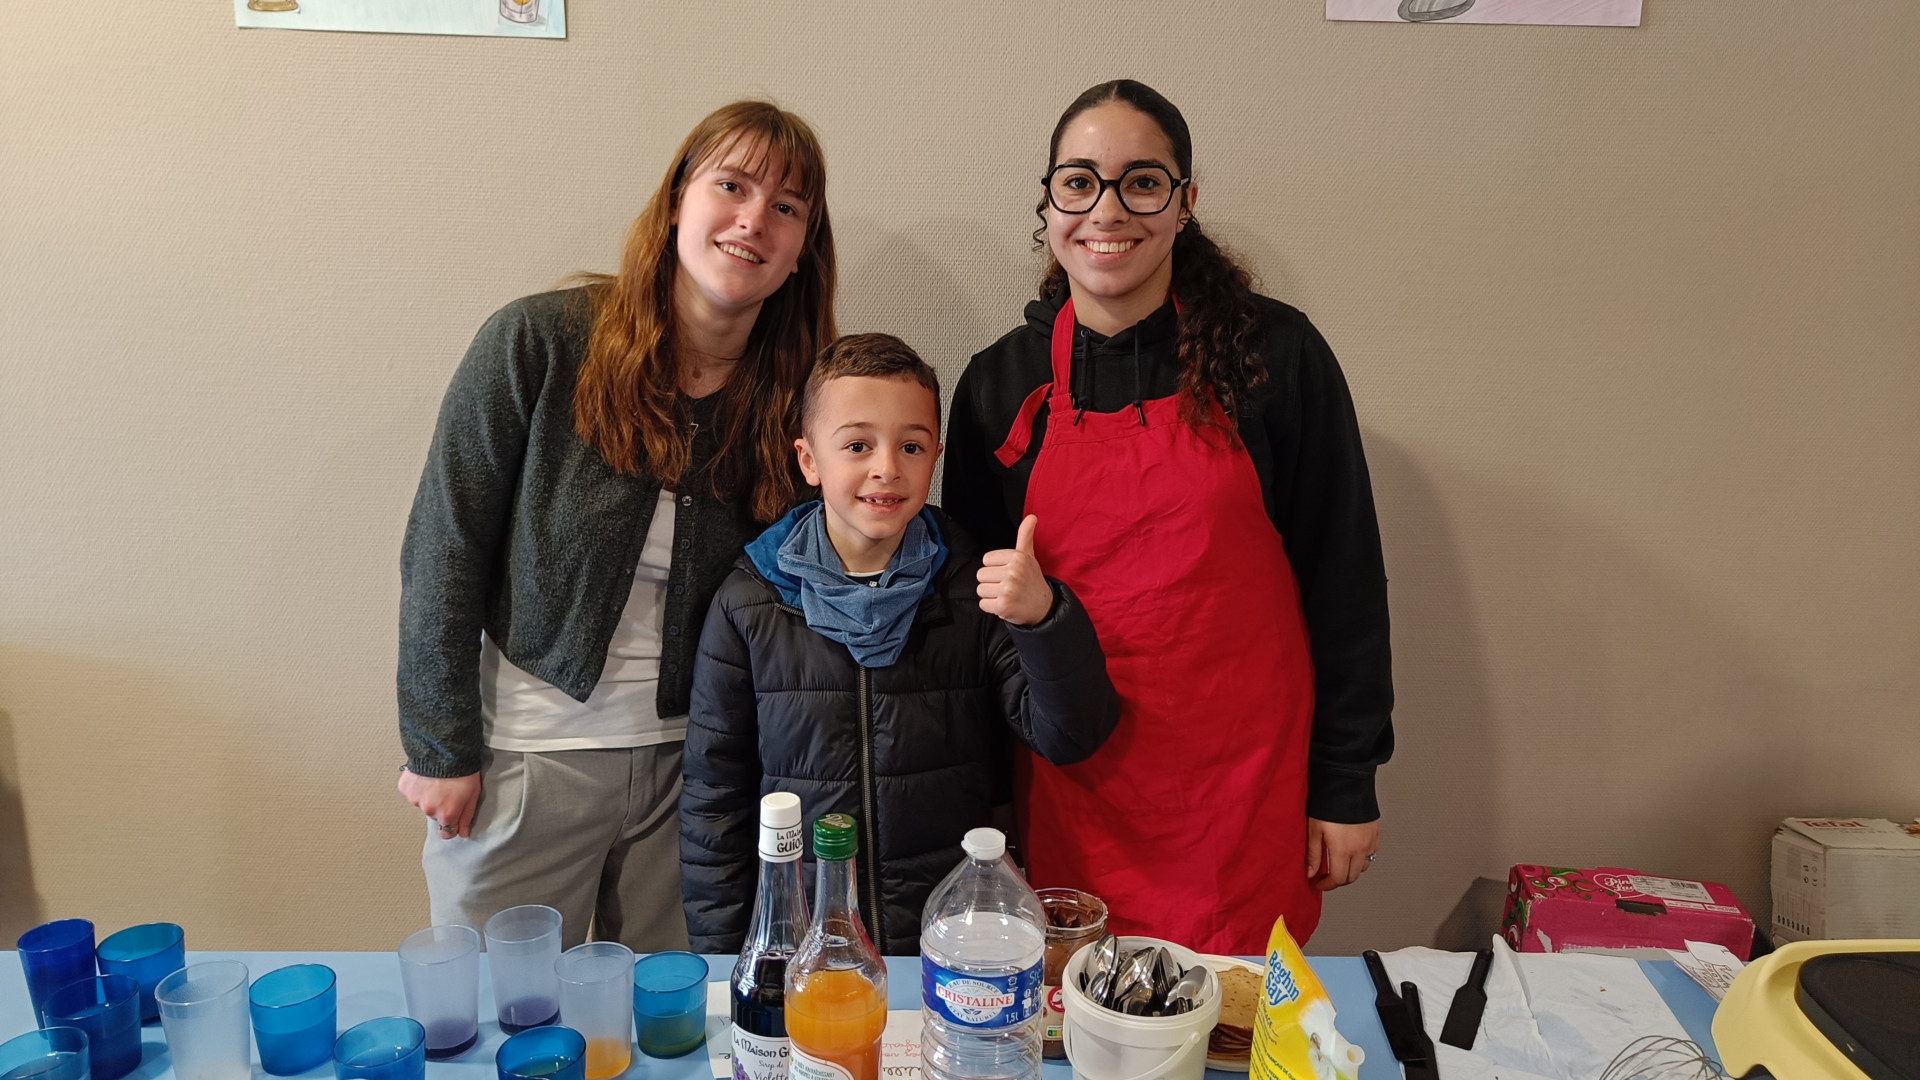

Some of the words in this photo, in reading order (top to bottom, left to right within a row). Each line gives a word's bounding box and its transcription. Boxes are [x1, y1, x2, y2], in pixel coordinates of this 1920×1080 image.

[949, 979, 960, 988] EAU
[972, 981, 1000, 994] SOURCE
[1268, 950, 1300, 1002] Béghin
[937, 985, 1013, 1007] CRISTALINE
[1265, 971, 1289, 1006] Say
[741, 1038, 777, 1058] Maison
